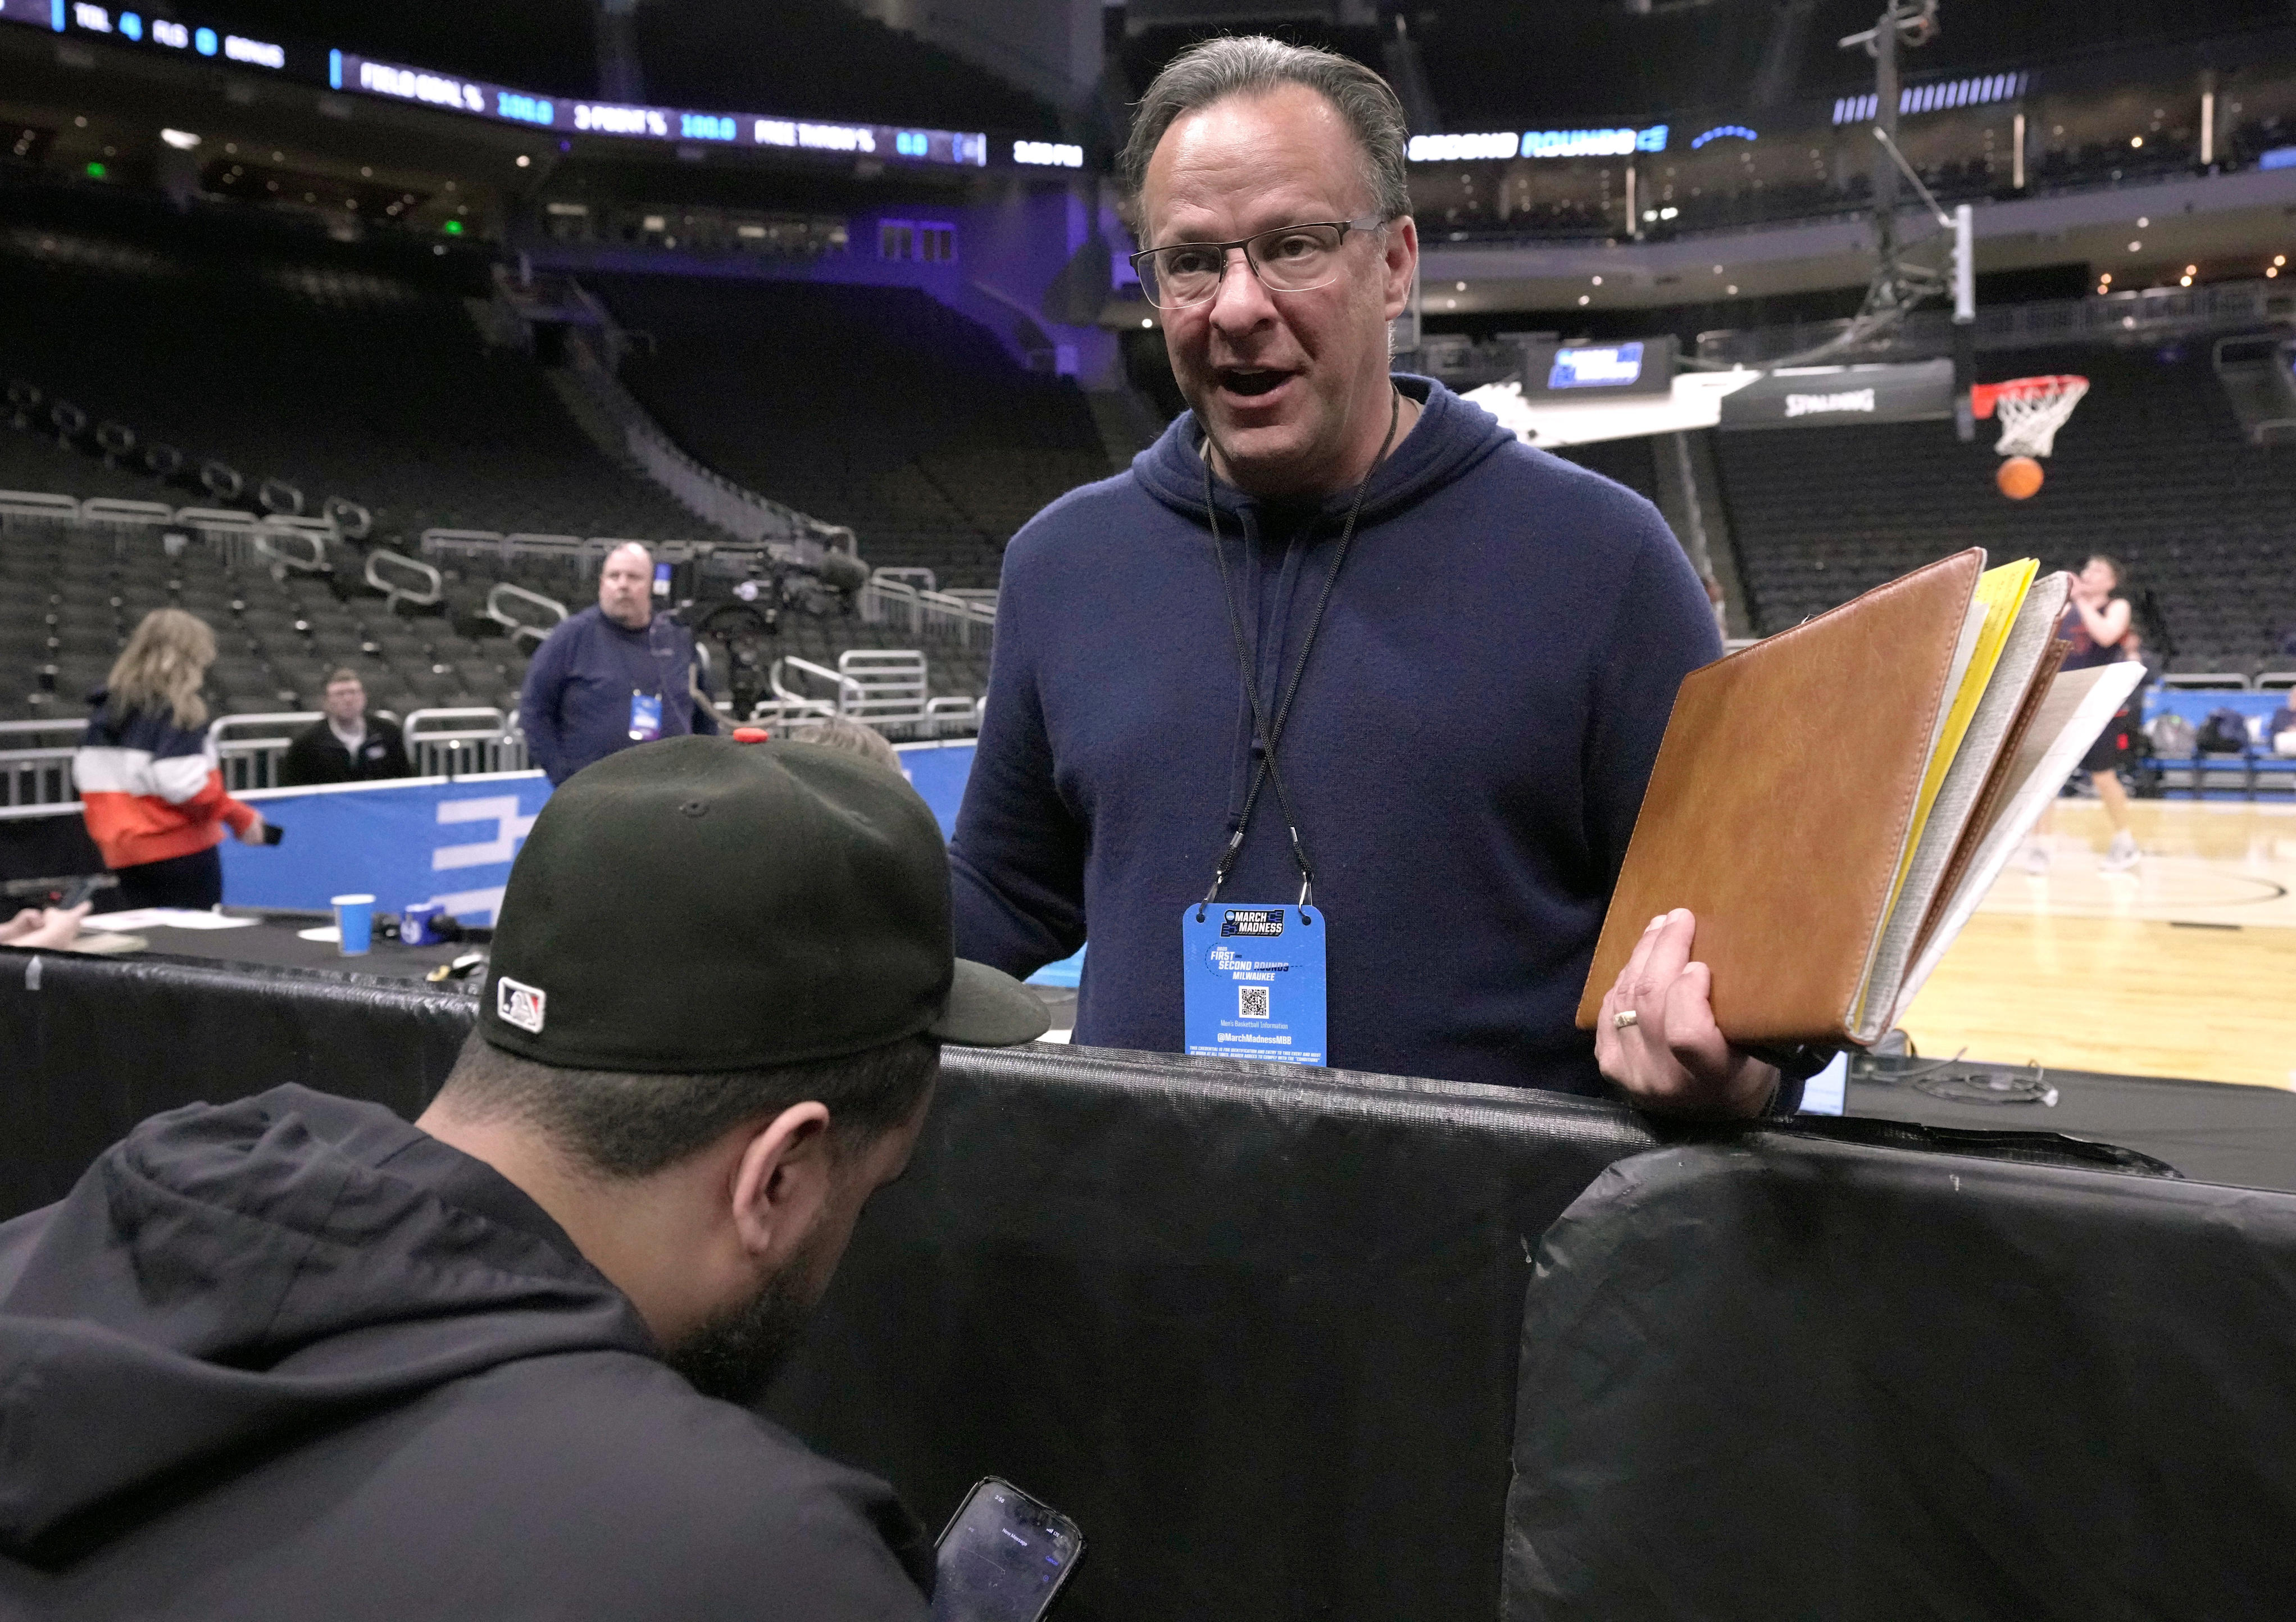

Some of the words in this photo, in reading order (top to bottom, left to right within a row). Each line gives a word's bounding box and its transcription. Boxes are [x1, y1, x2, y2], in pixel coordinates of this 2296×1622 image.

[1785, 388, 1875, 417] SPALDING
[1235, 911, 1267, 922] MARCH
[1239, 922, 1283, 933] MADNESS
[1211, 951, 1235, 960] FIRST
[1219, 961, 1252, 970] SECOND
[1254, 961, 1289, 972] ROUNDS
[1233, 971, 1275, 981] MILWAUKEE
[1217, 1033, 1292, 1044] @MarchMadnessMBB
[1002, 1528, 1012, 1537] New
[1011, 1533, 1027, 1546] Message
